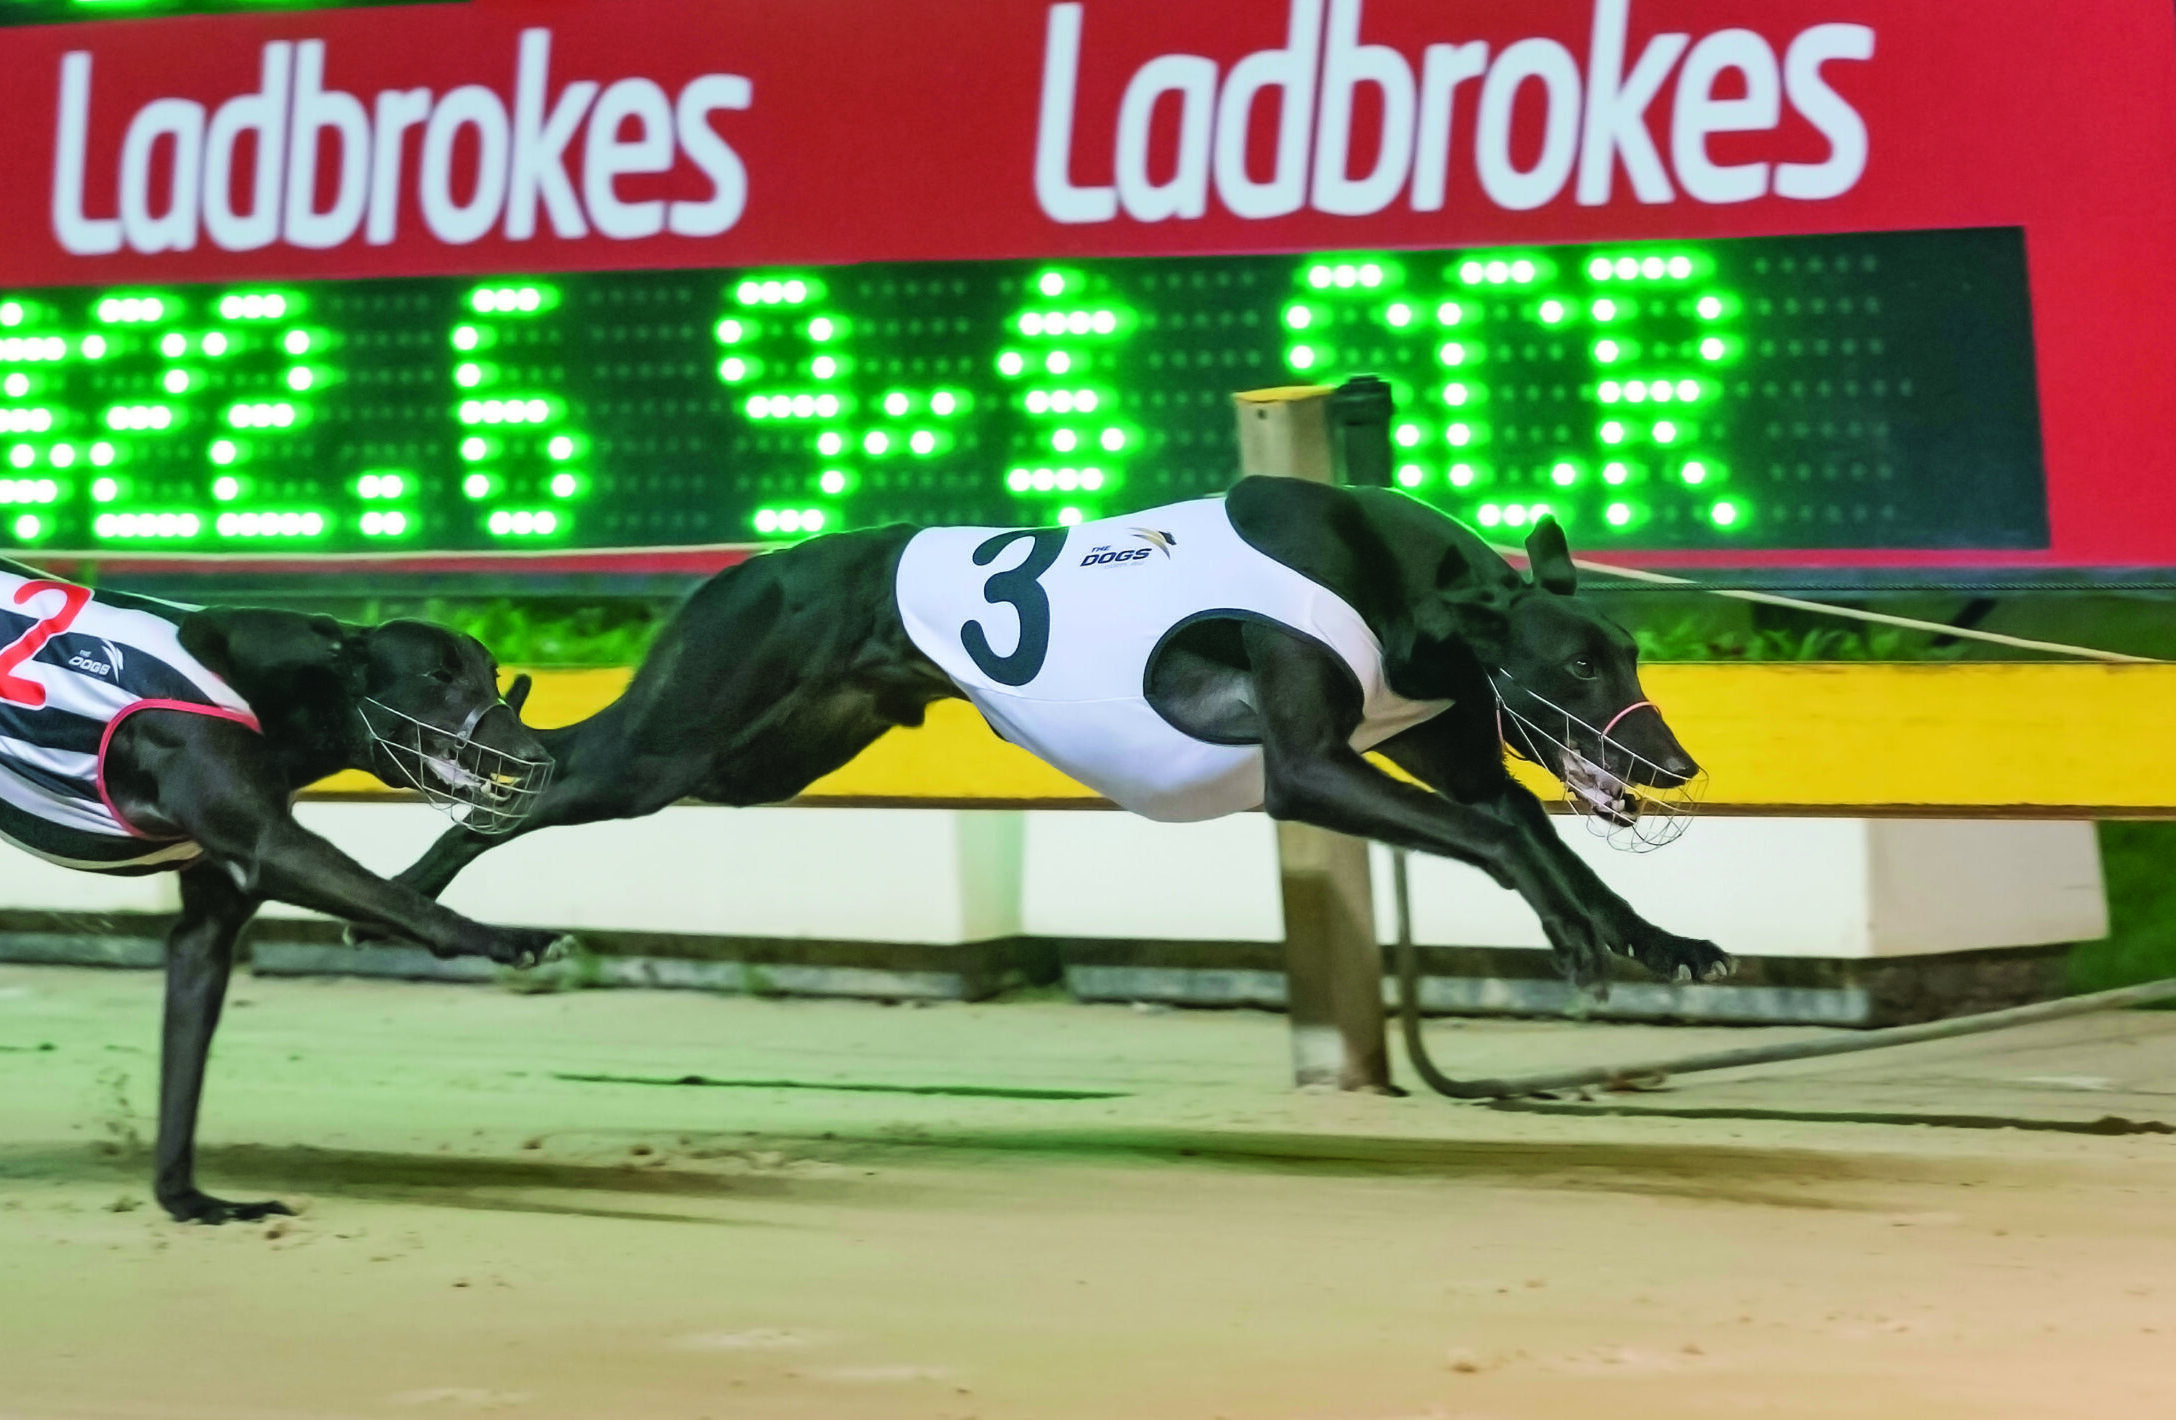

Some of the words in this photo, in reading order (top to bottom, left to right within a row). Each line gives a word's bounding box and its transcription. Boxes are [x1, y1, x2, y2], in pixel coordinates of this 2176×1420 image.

[52, 27, 752, 255] Ladbrokes
[1034, 0, 1876, 224] Ladbrokes
[960, 526, 1070, 687] 3
[1079, 547, 1152, 567] DOGS
[0, 579, 93, 708] 2
[68, 656, 111, 676] DOGS
